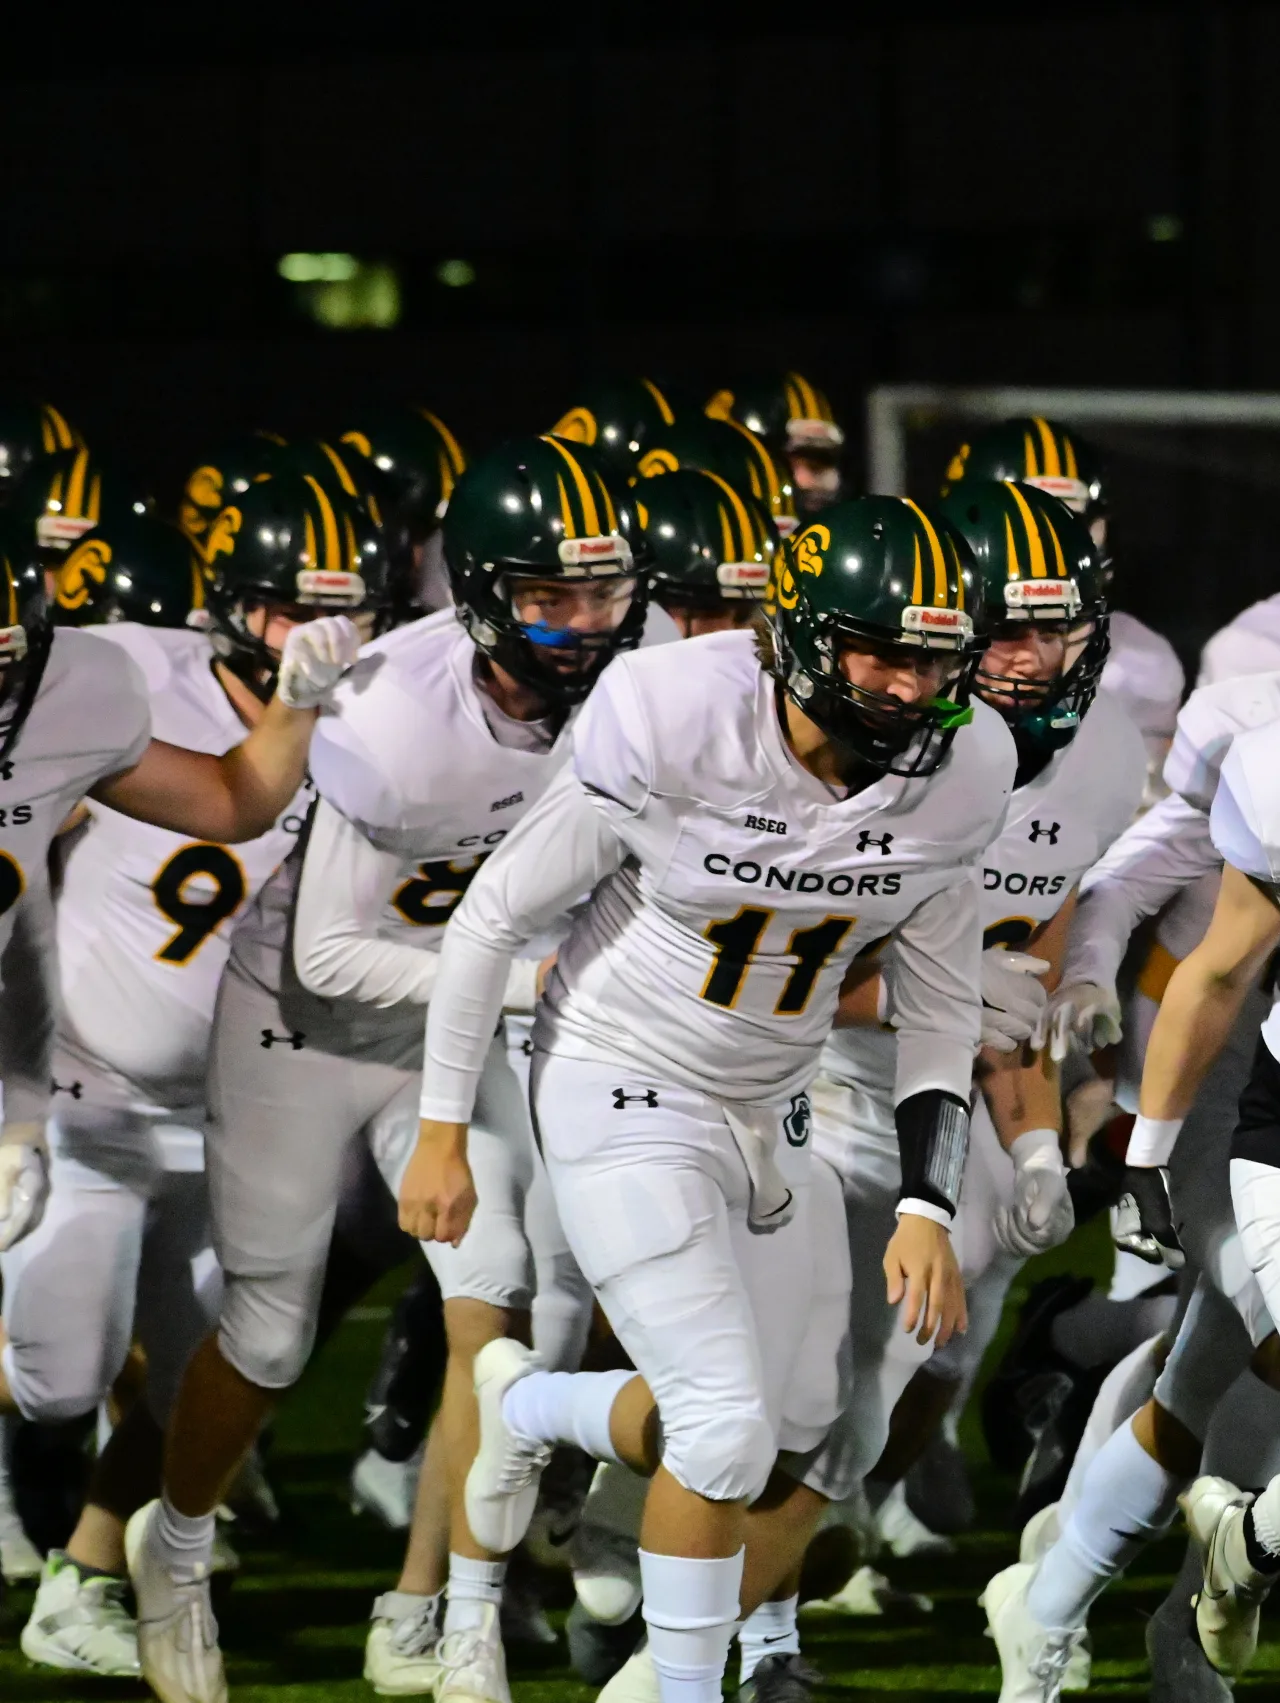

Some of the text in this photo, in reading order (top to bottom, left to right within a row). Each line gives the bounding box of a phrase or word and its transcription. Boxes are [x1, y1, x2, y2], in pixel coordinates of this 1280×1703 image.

[744, 814, 788, 836] RSEQ
[703, 853, 902, 897] CONDORS
[983, 867, 1066, 896] DORS
[152, 840, 247, 967] 9
[701, 904, 857, 1016] 11
